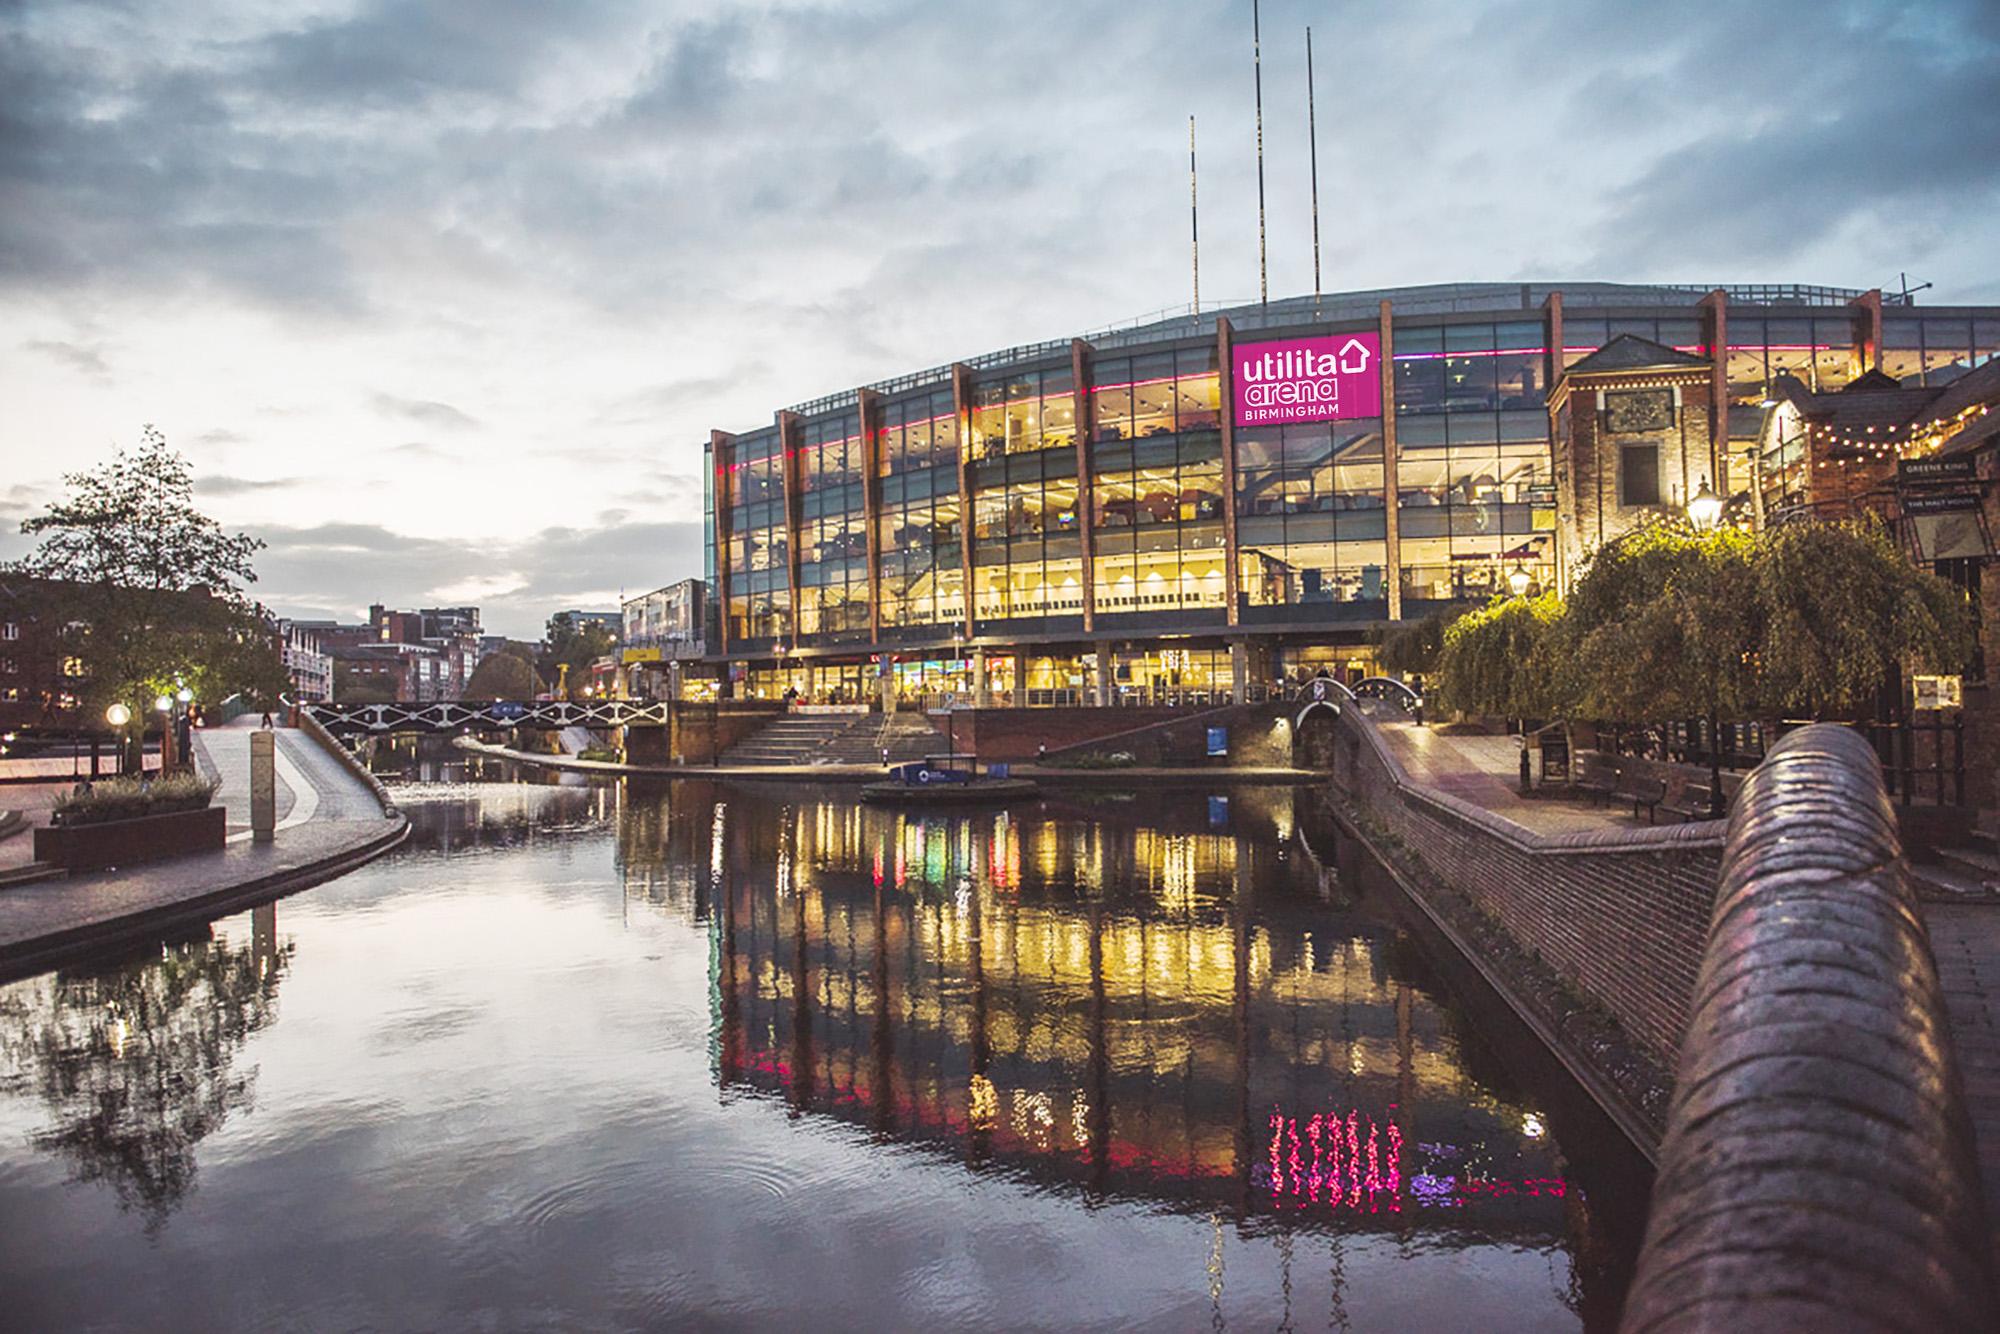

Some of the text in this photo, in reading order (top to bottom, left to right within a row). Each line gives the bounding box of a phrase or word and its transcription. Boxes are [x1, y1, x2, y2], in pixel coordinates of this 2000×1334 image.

[1243, 349, 1337, 382] utilita
[1245, 378, 1338, 407] arena
[1245, 404, 1339, 421] BIRMINGHAM
[1906, 465, 1941, 473] GREENE
